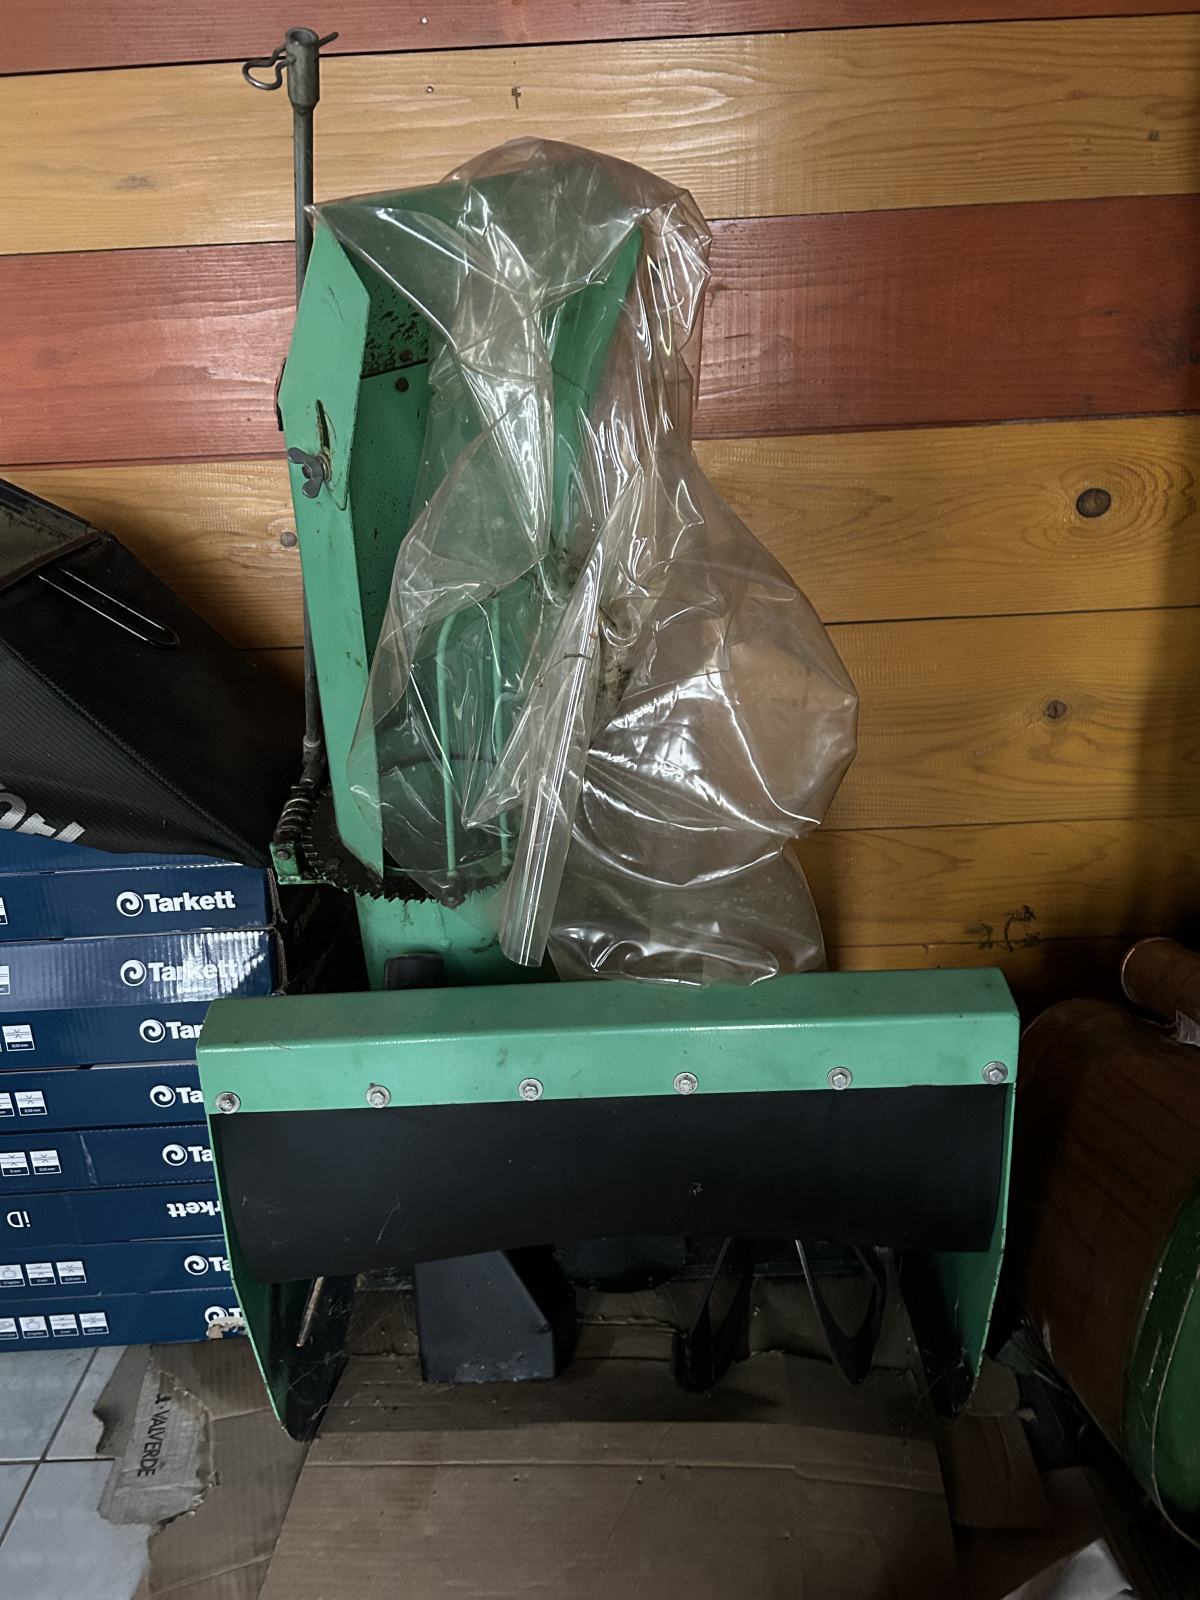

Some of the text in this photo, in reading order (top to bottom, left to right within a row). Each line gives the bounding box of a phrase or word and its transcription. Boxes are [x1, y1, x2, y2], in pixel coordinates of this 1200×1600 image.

[143, 890, 236, 913] Tarkett
[148, 958, 238, 982] Tarkett
[6, 1210, 31, 1228] iD
